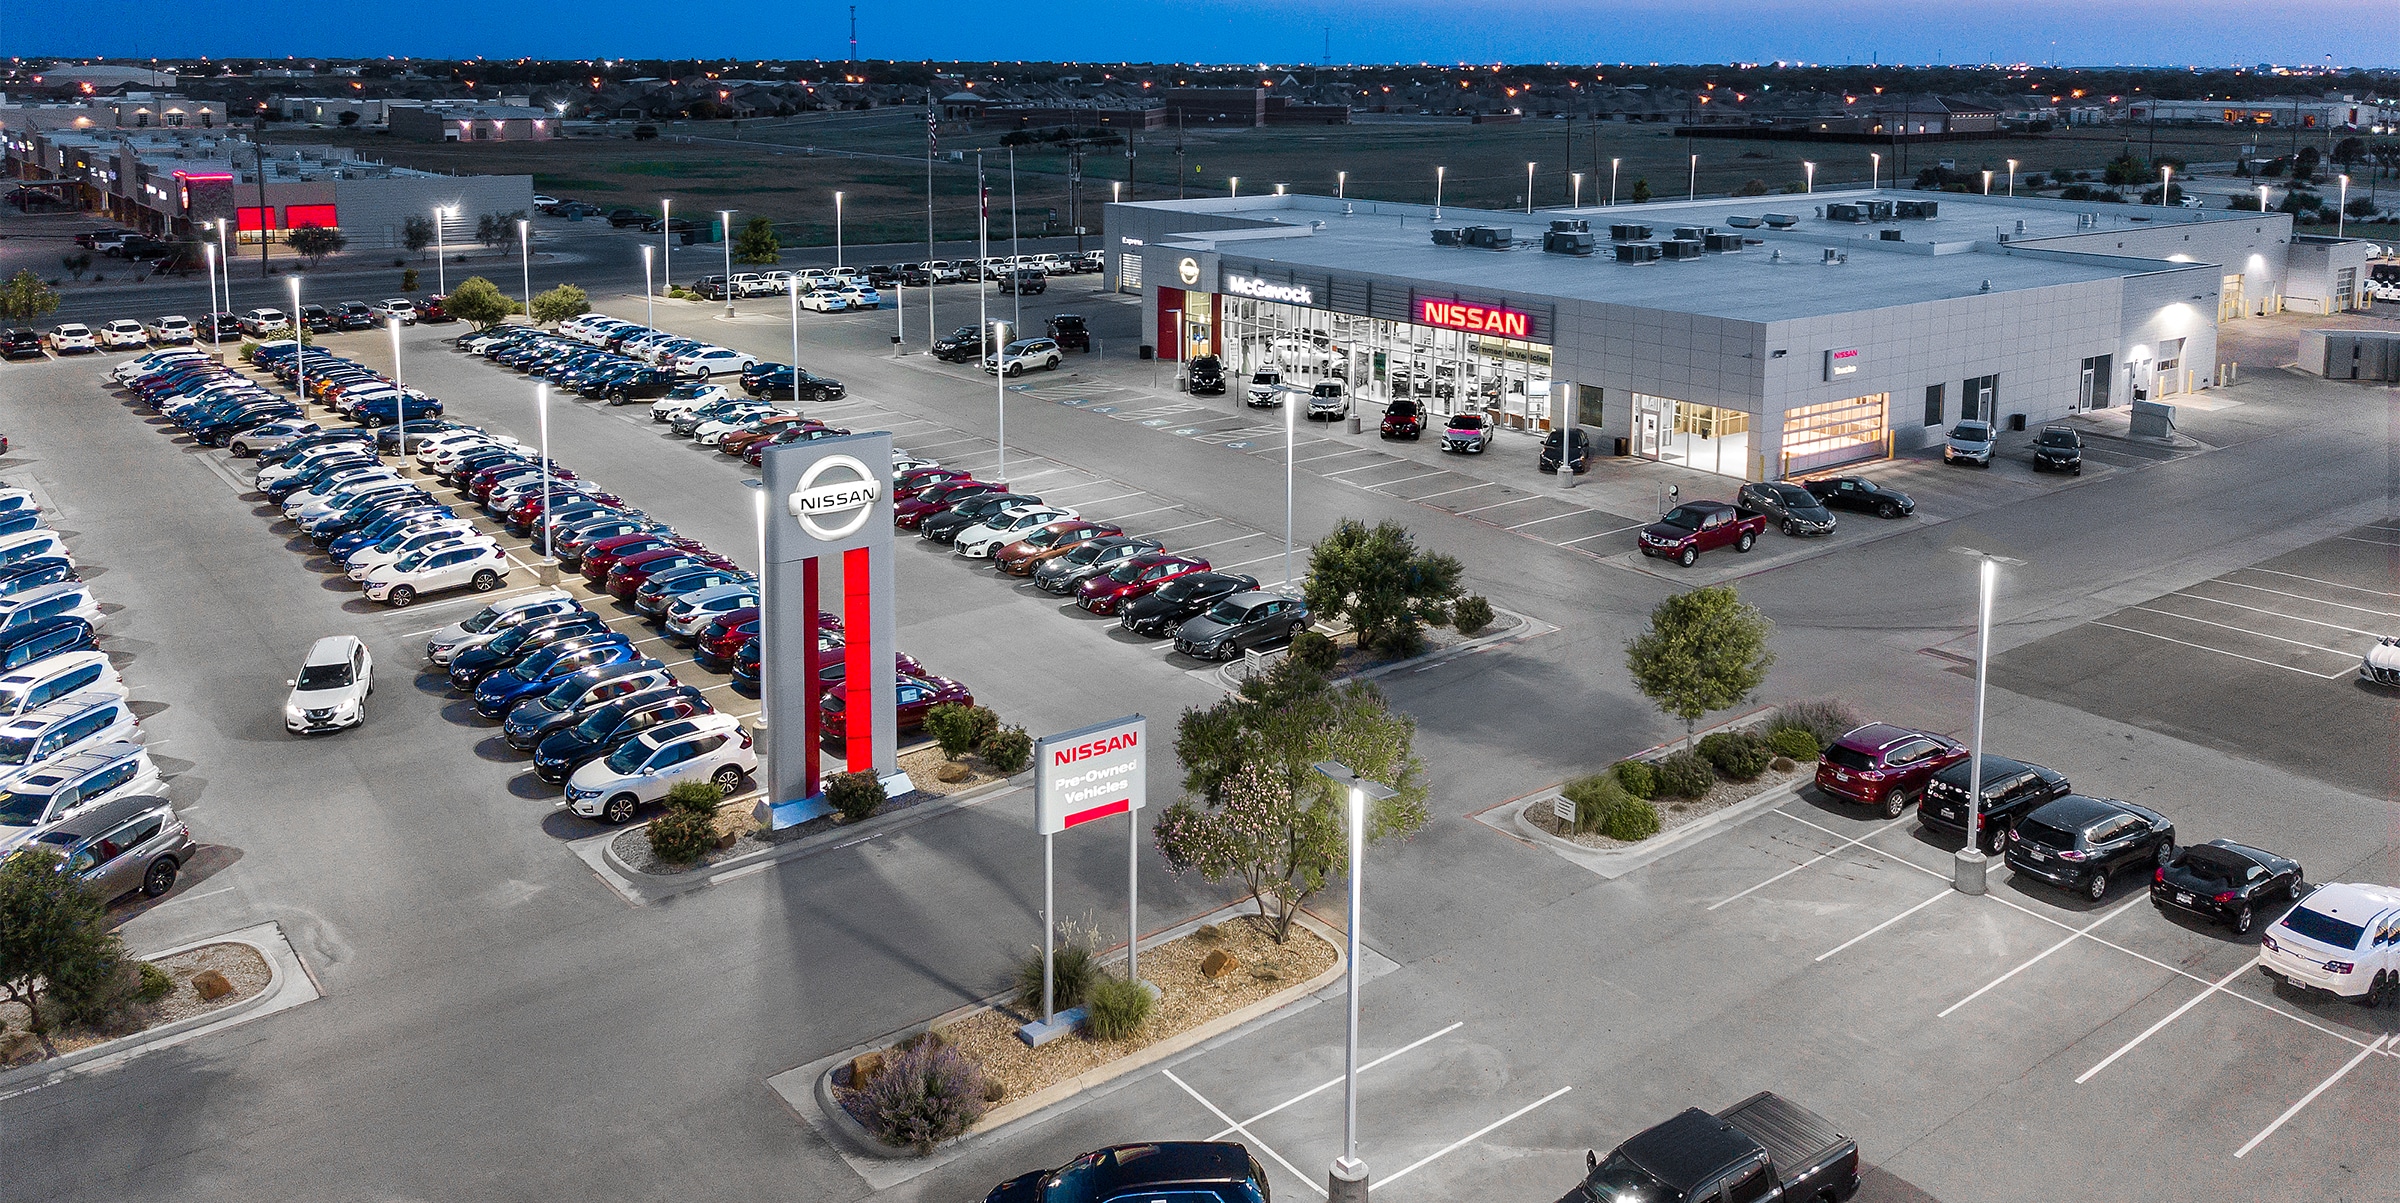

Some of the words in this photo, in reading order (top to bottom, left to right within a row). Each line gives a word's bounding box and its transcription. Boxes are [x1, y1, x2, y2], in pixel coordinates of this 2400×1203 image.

[1230, 276, 1312, 304] McGavock
[1425, 302, 1525, 336] NISSAN
[1834, 350, 1858, 359] NISSAN
[801, 487, 874, 510] NISSAN
[1055, 731, 1138, 767] NISSAN
[1055, 759, 1137, 791] Pre-Owned
[1064, 779, 1129, 804] Vehicles
